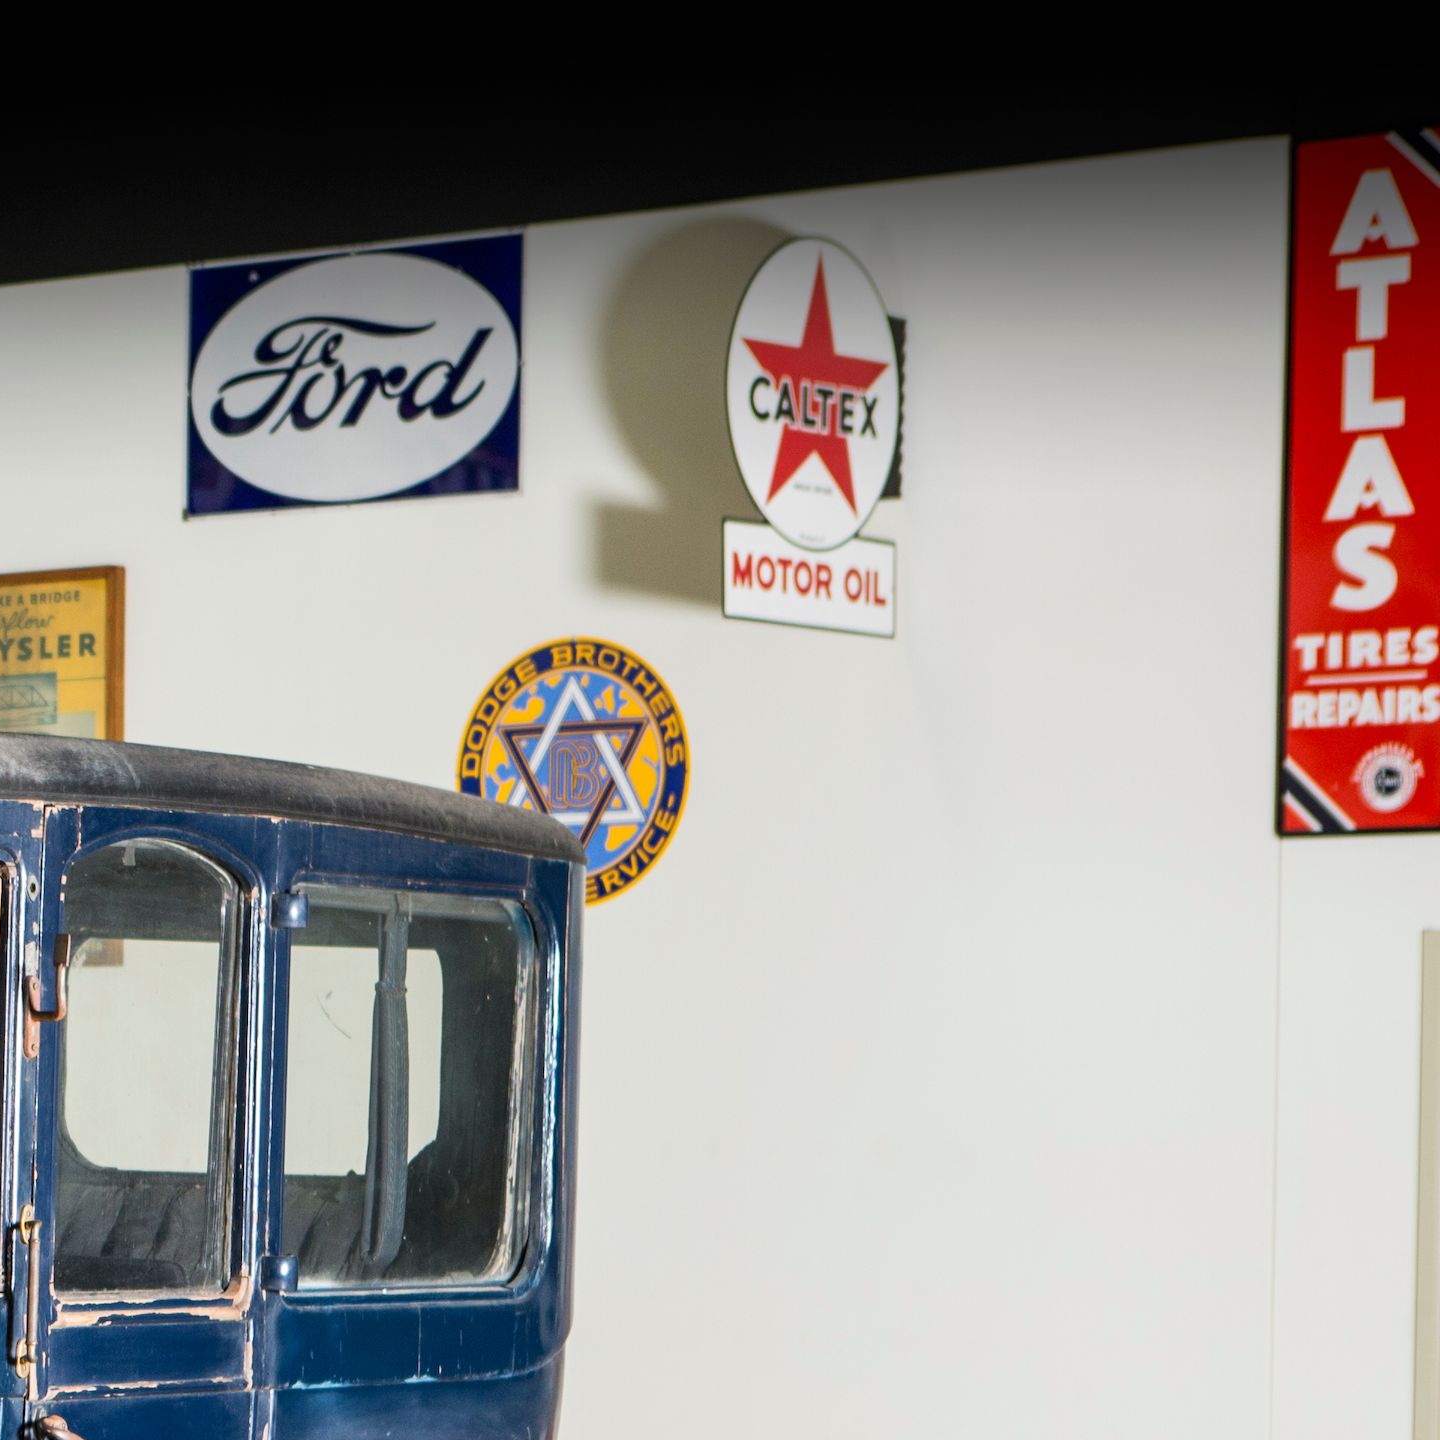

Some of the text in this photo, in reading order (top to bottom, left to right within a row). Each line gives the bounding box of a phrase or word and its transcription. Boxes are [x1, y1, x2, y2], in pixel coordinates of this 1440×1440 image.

[210, 315, 494, 437] Ford
[1321, 168, 1419, 611] ATLAS
[749, 376, 879, 439] CALTEX
[16, 593, 25, 606] A
[30, 590, 81, 605] BRIDGE
[732, 551, 886, 606] MOTOR OIL
[1294, 626, 1439, 669] TIRES
[462, 644, 684, 778] DODGE BROTHERS
[1289, 685, 1440, 730] REPAIRS
